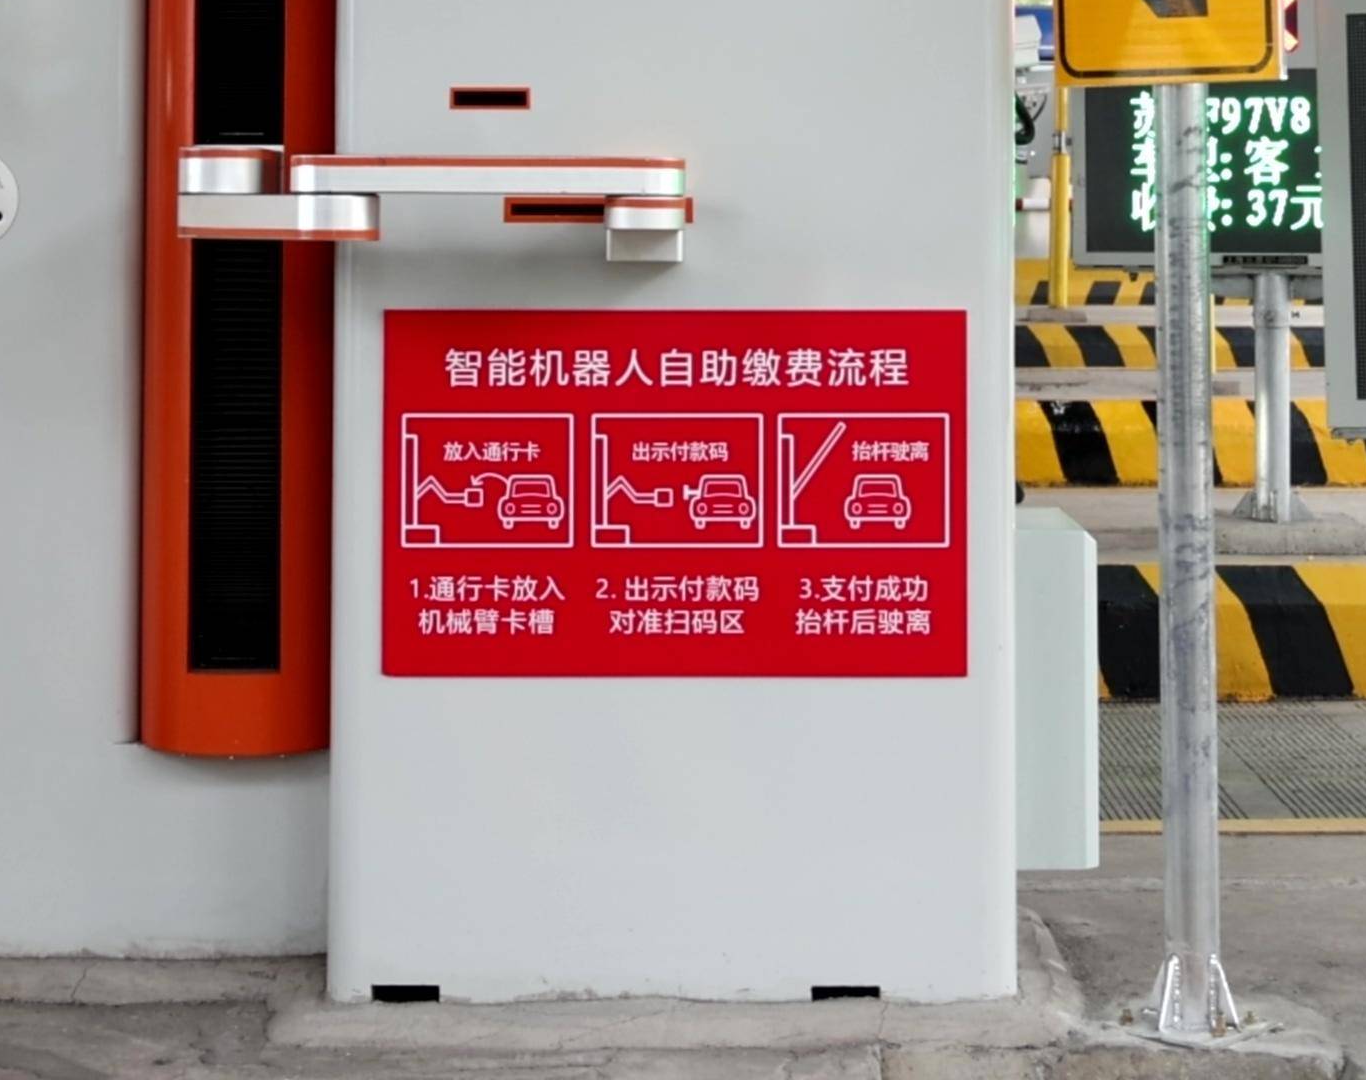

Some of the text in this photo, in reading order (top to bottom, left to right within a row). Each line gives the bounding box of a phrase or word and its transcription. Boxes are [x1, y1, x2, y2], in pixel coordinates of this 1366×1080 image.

[444, 347, 910, 388] 智能机器人自助缴费流程
[443, 440, 541, 462] 放入通行卡
[631, 440, 729, 462] 出示付款码
[851, 440, 929, 462] 抬杆驶离
[409, 576, 566, 603] 1.通行卡放入
[798, 576, 929, 603] 3.支付成功
[418, 608, 555, 636] 机械臂卡槽
[609, 608, 745, 636] 对准扫码区
[795, 608, 932, 636] 抬杆后驶离
